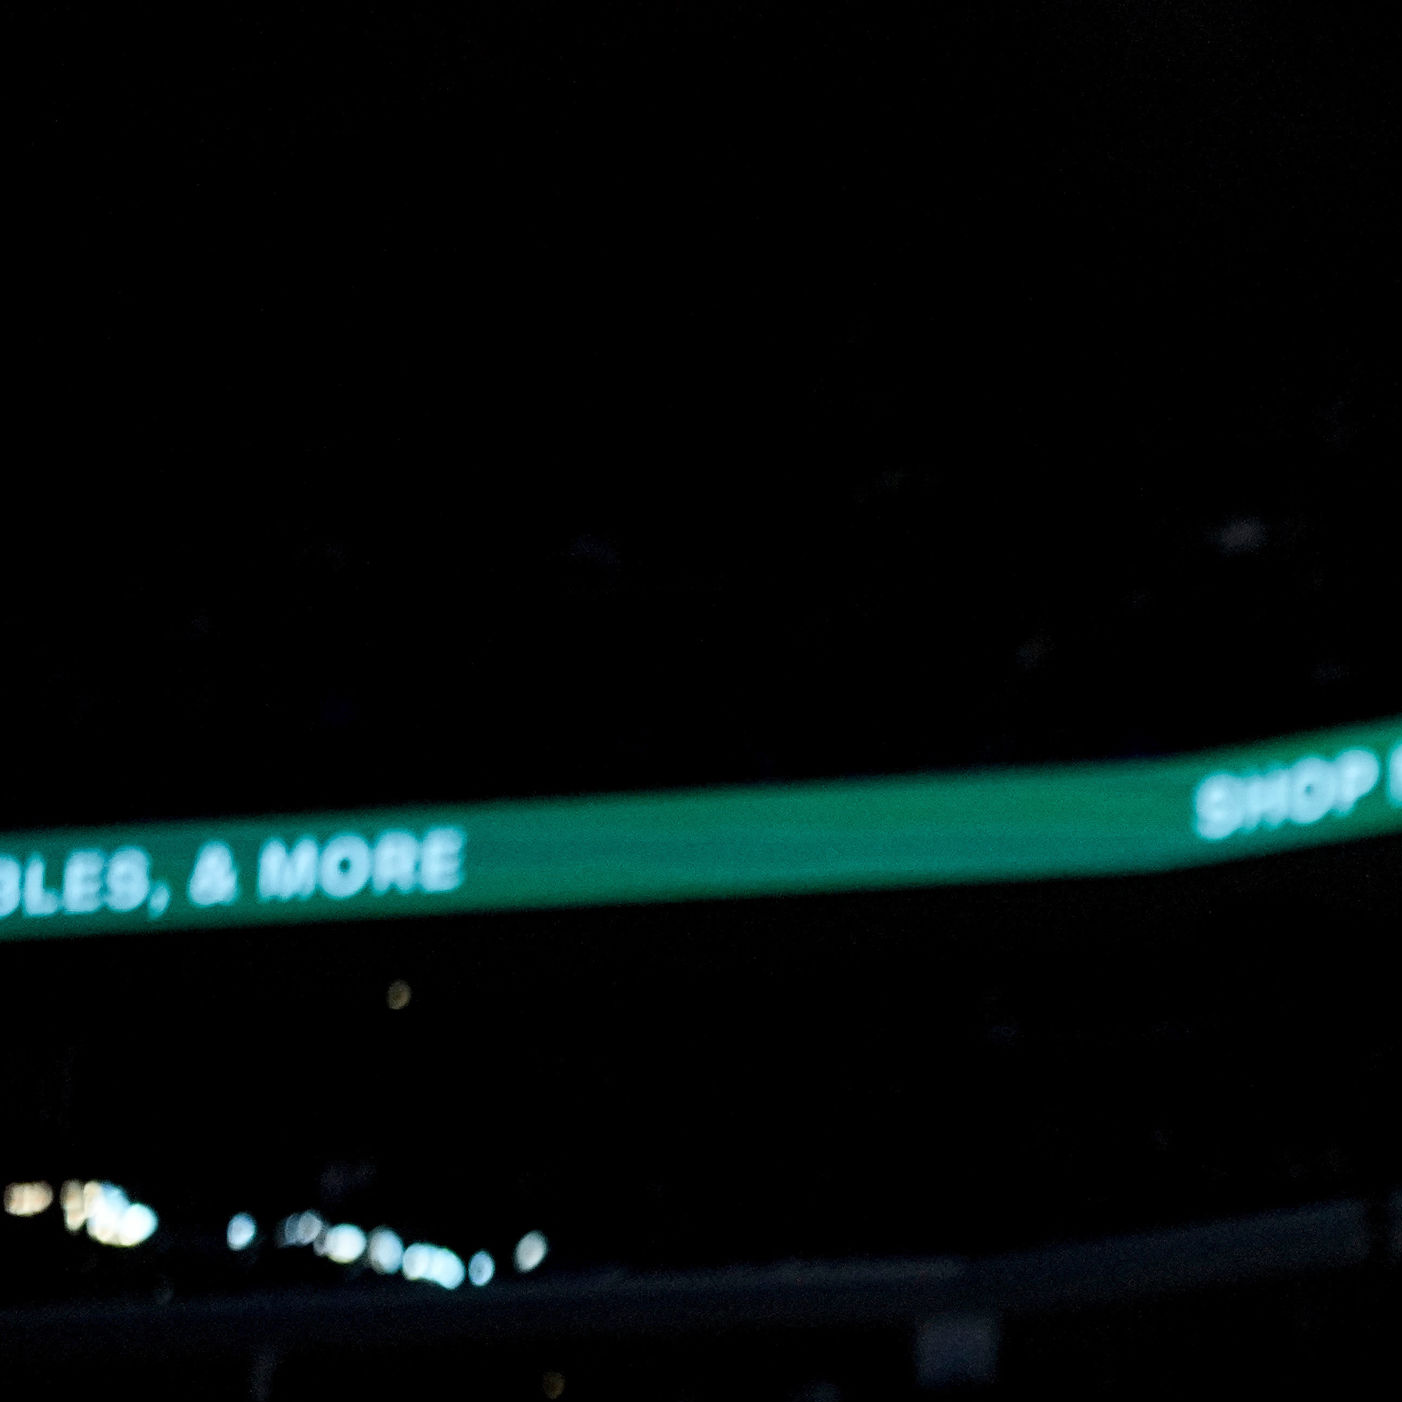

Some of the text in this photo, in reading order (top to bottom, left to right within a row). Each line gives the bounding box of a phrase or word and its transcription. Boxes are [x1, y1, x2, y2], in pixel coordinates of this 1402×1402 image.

[1193, 749, 1381, 839] SHOP
[187, 839, 241, 908] &
[257, 826, 465, 900] MORE
